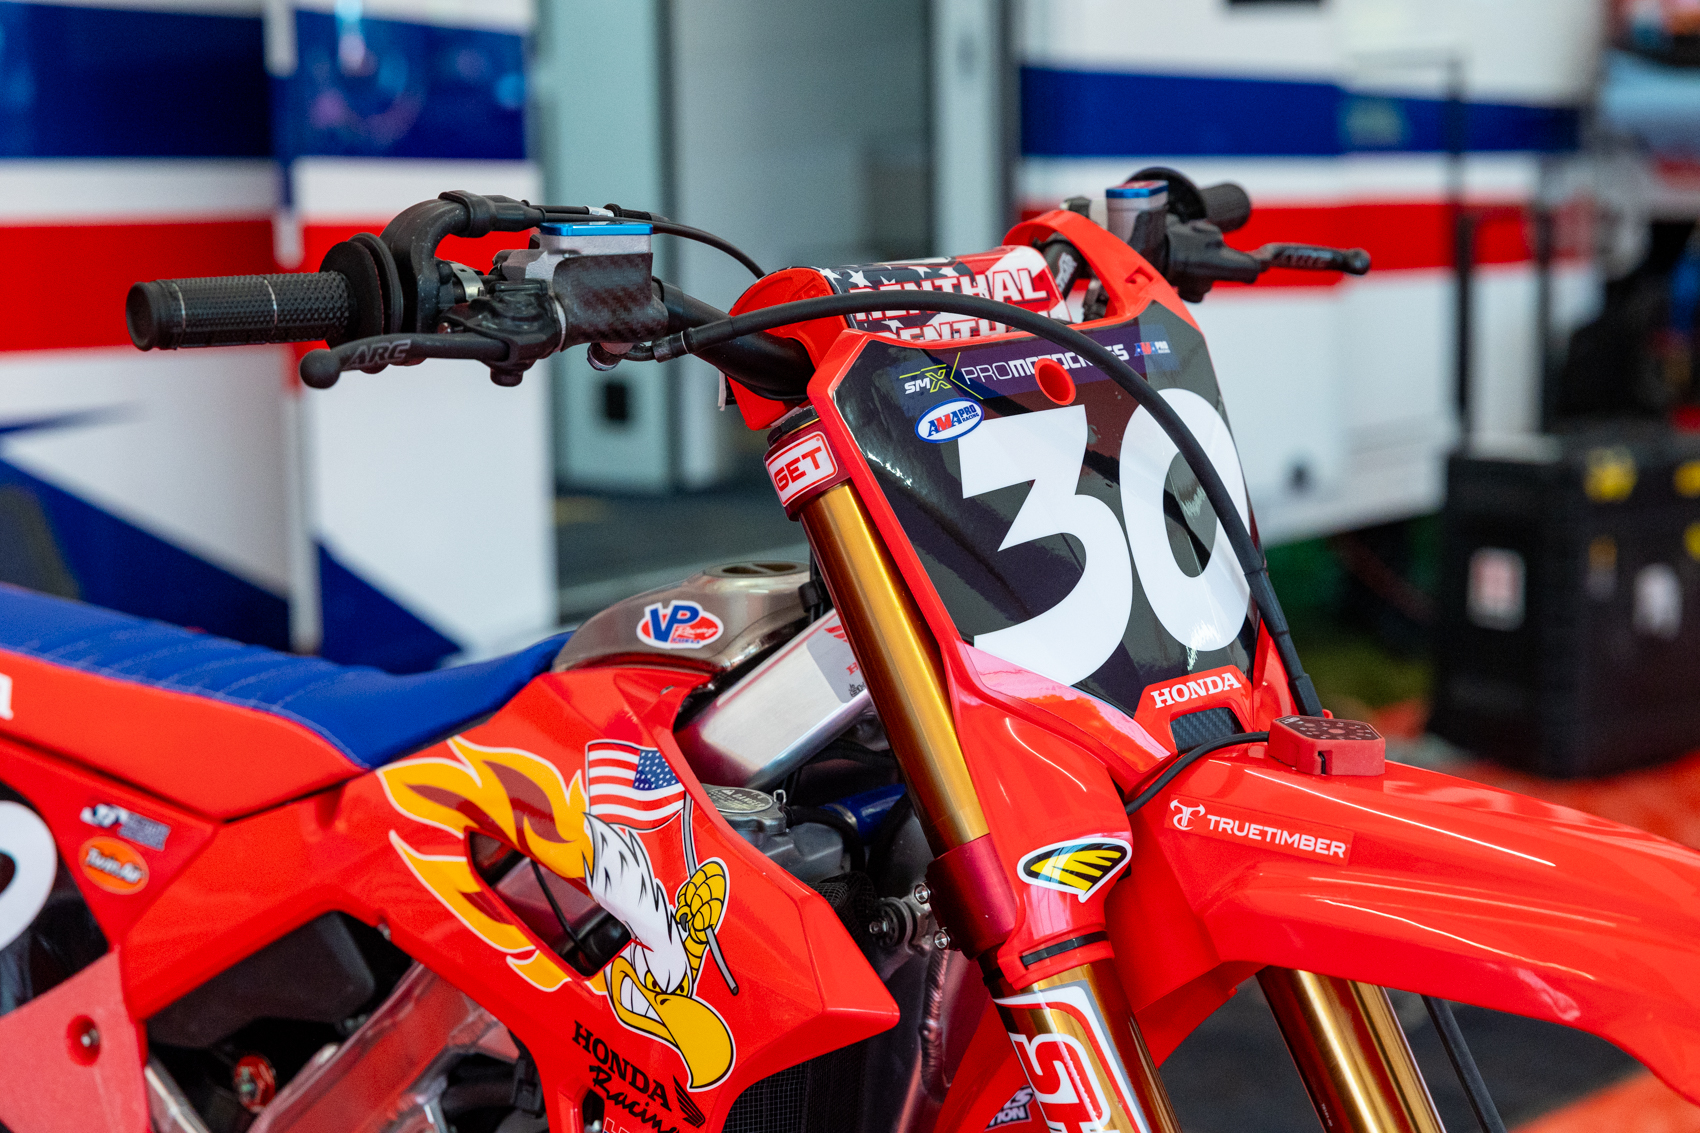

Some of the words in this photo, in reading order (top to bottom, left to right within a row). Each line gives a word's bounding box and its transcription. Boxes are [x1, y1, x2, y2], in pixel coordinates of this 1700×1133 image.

[347, 339, 411, 366] ARC
[904, 369, 952, 394] SMX
[927, 410, 963, 438] AMA
[959, 404, 977, 418] PRO
[962, 412, 980, 423] RACING
[957, 387, 1251, 687] 30
[650, 604, 700, 643] VP
[1150, 672, 1242, 709] HONDA
[1206, 814, 1347, 858] TRUETIMBER
[572, 1020, 672, 1112] HONDA
